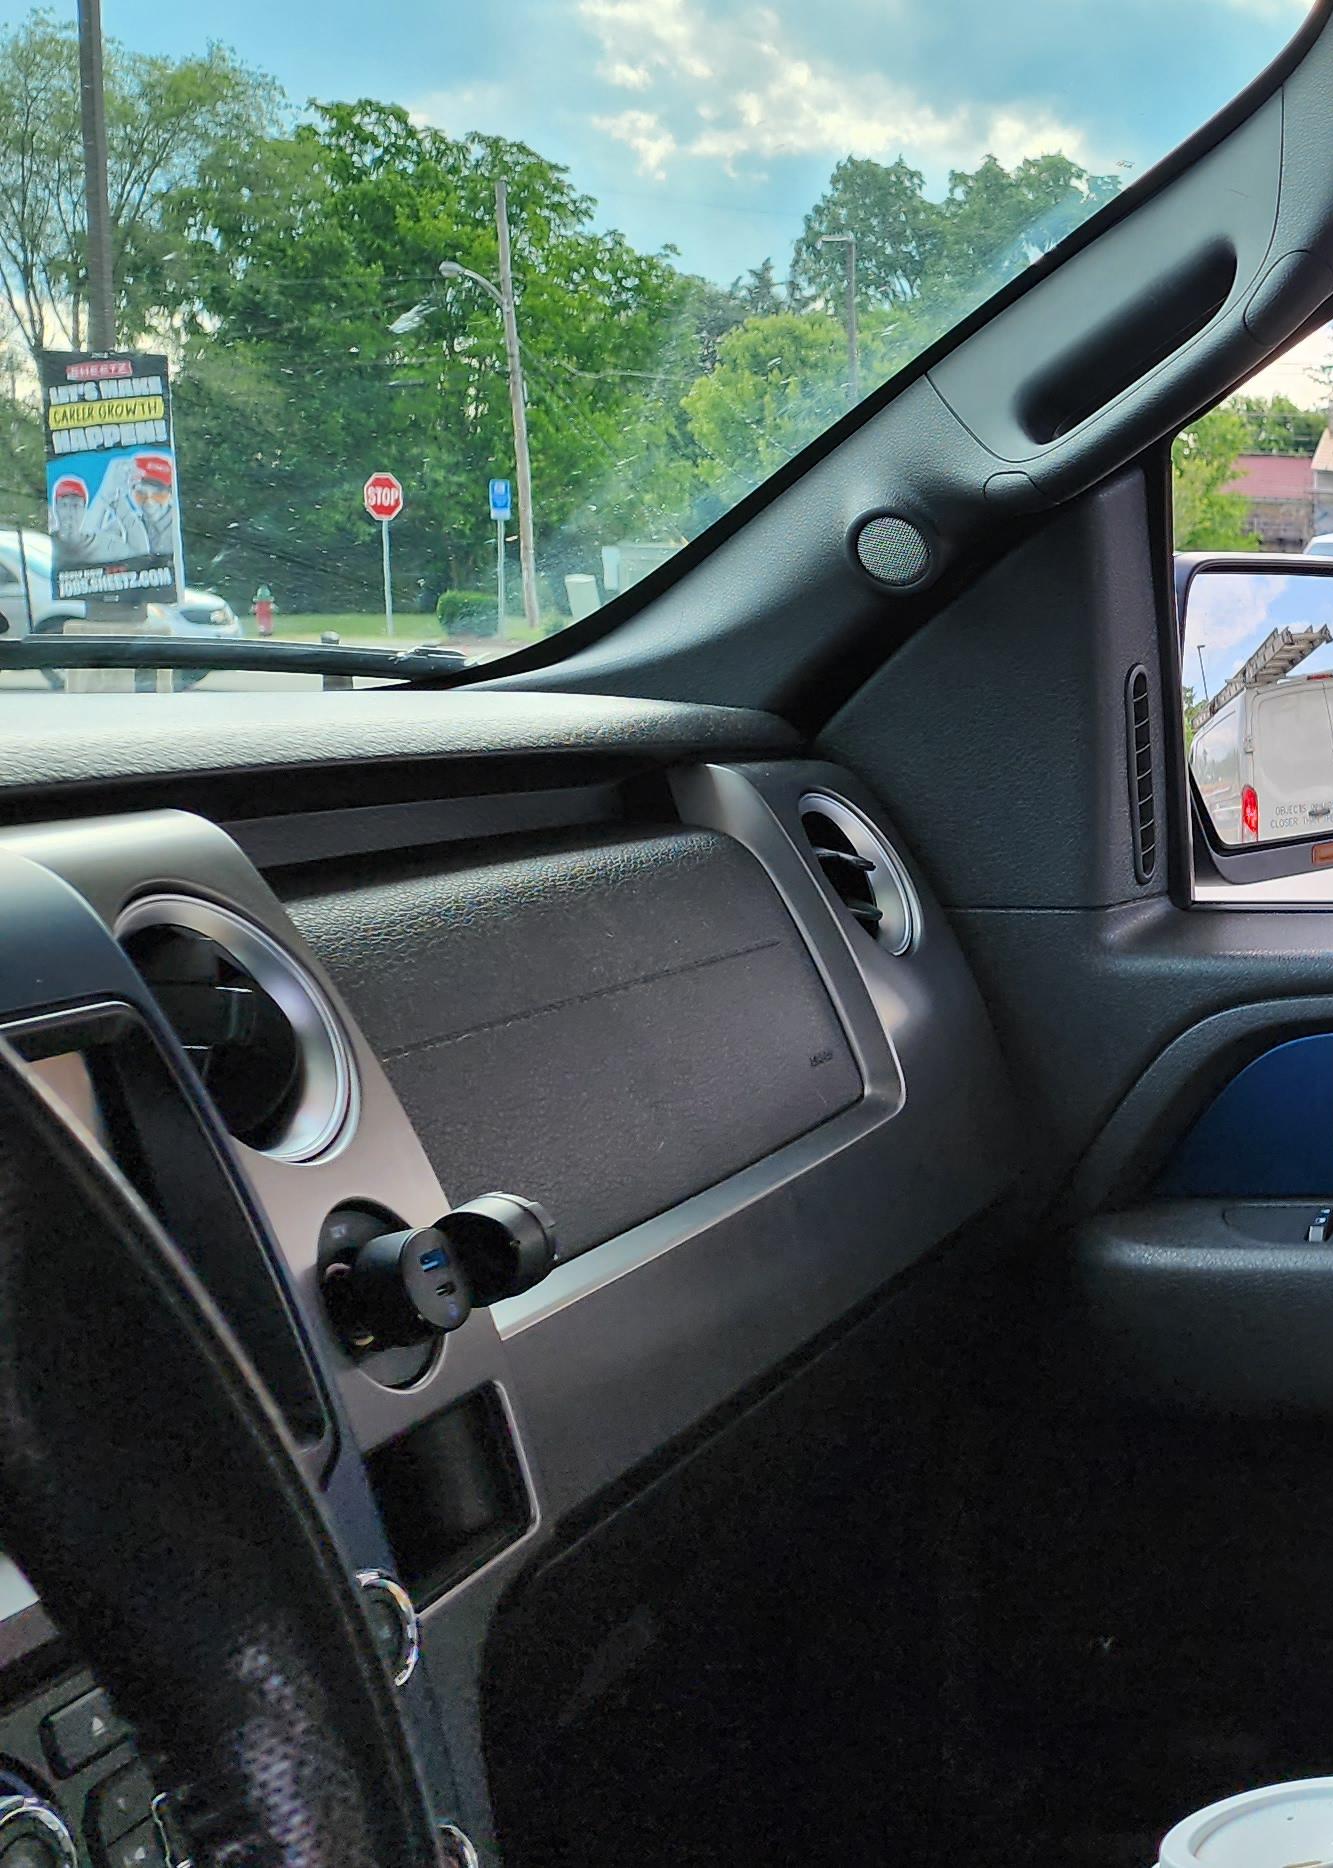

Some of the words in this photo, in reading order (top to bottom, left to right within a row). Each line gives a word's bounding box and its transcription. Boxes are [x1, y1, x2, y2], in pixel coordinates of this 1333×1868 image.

[53, 405, 95, 424] CAREER
[98, 401, 157, 422] GROWTH
[367, 486, 399, 507] STOP
[1275, 804, 1307, 816] OBJECTS
[1270, 816, 1298, 829] CLOSER
